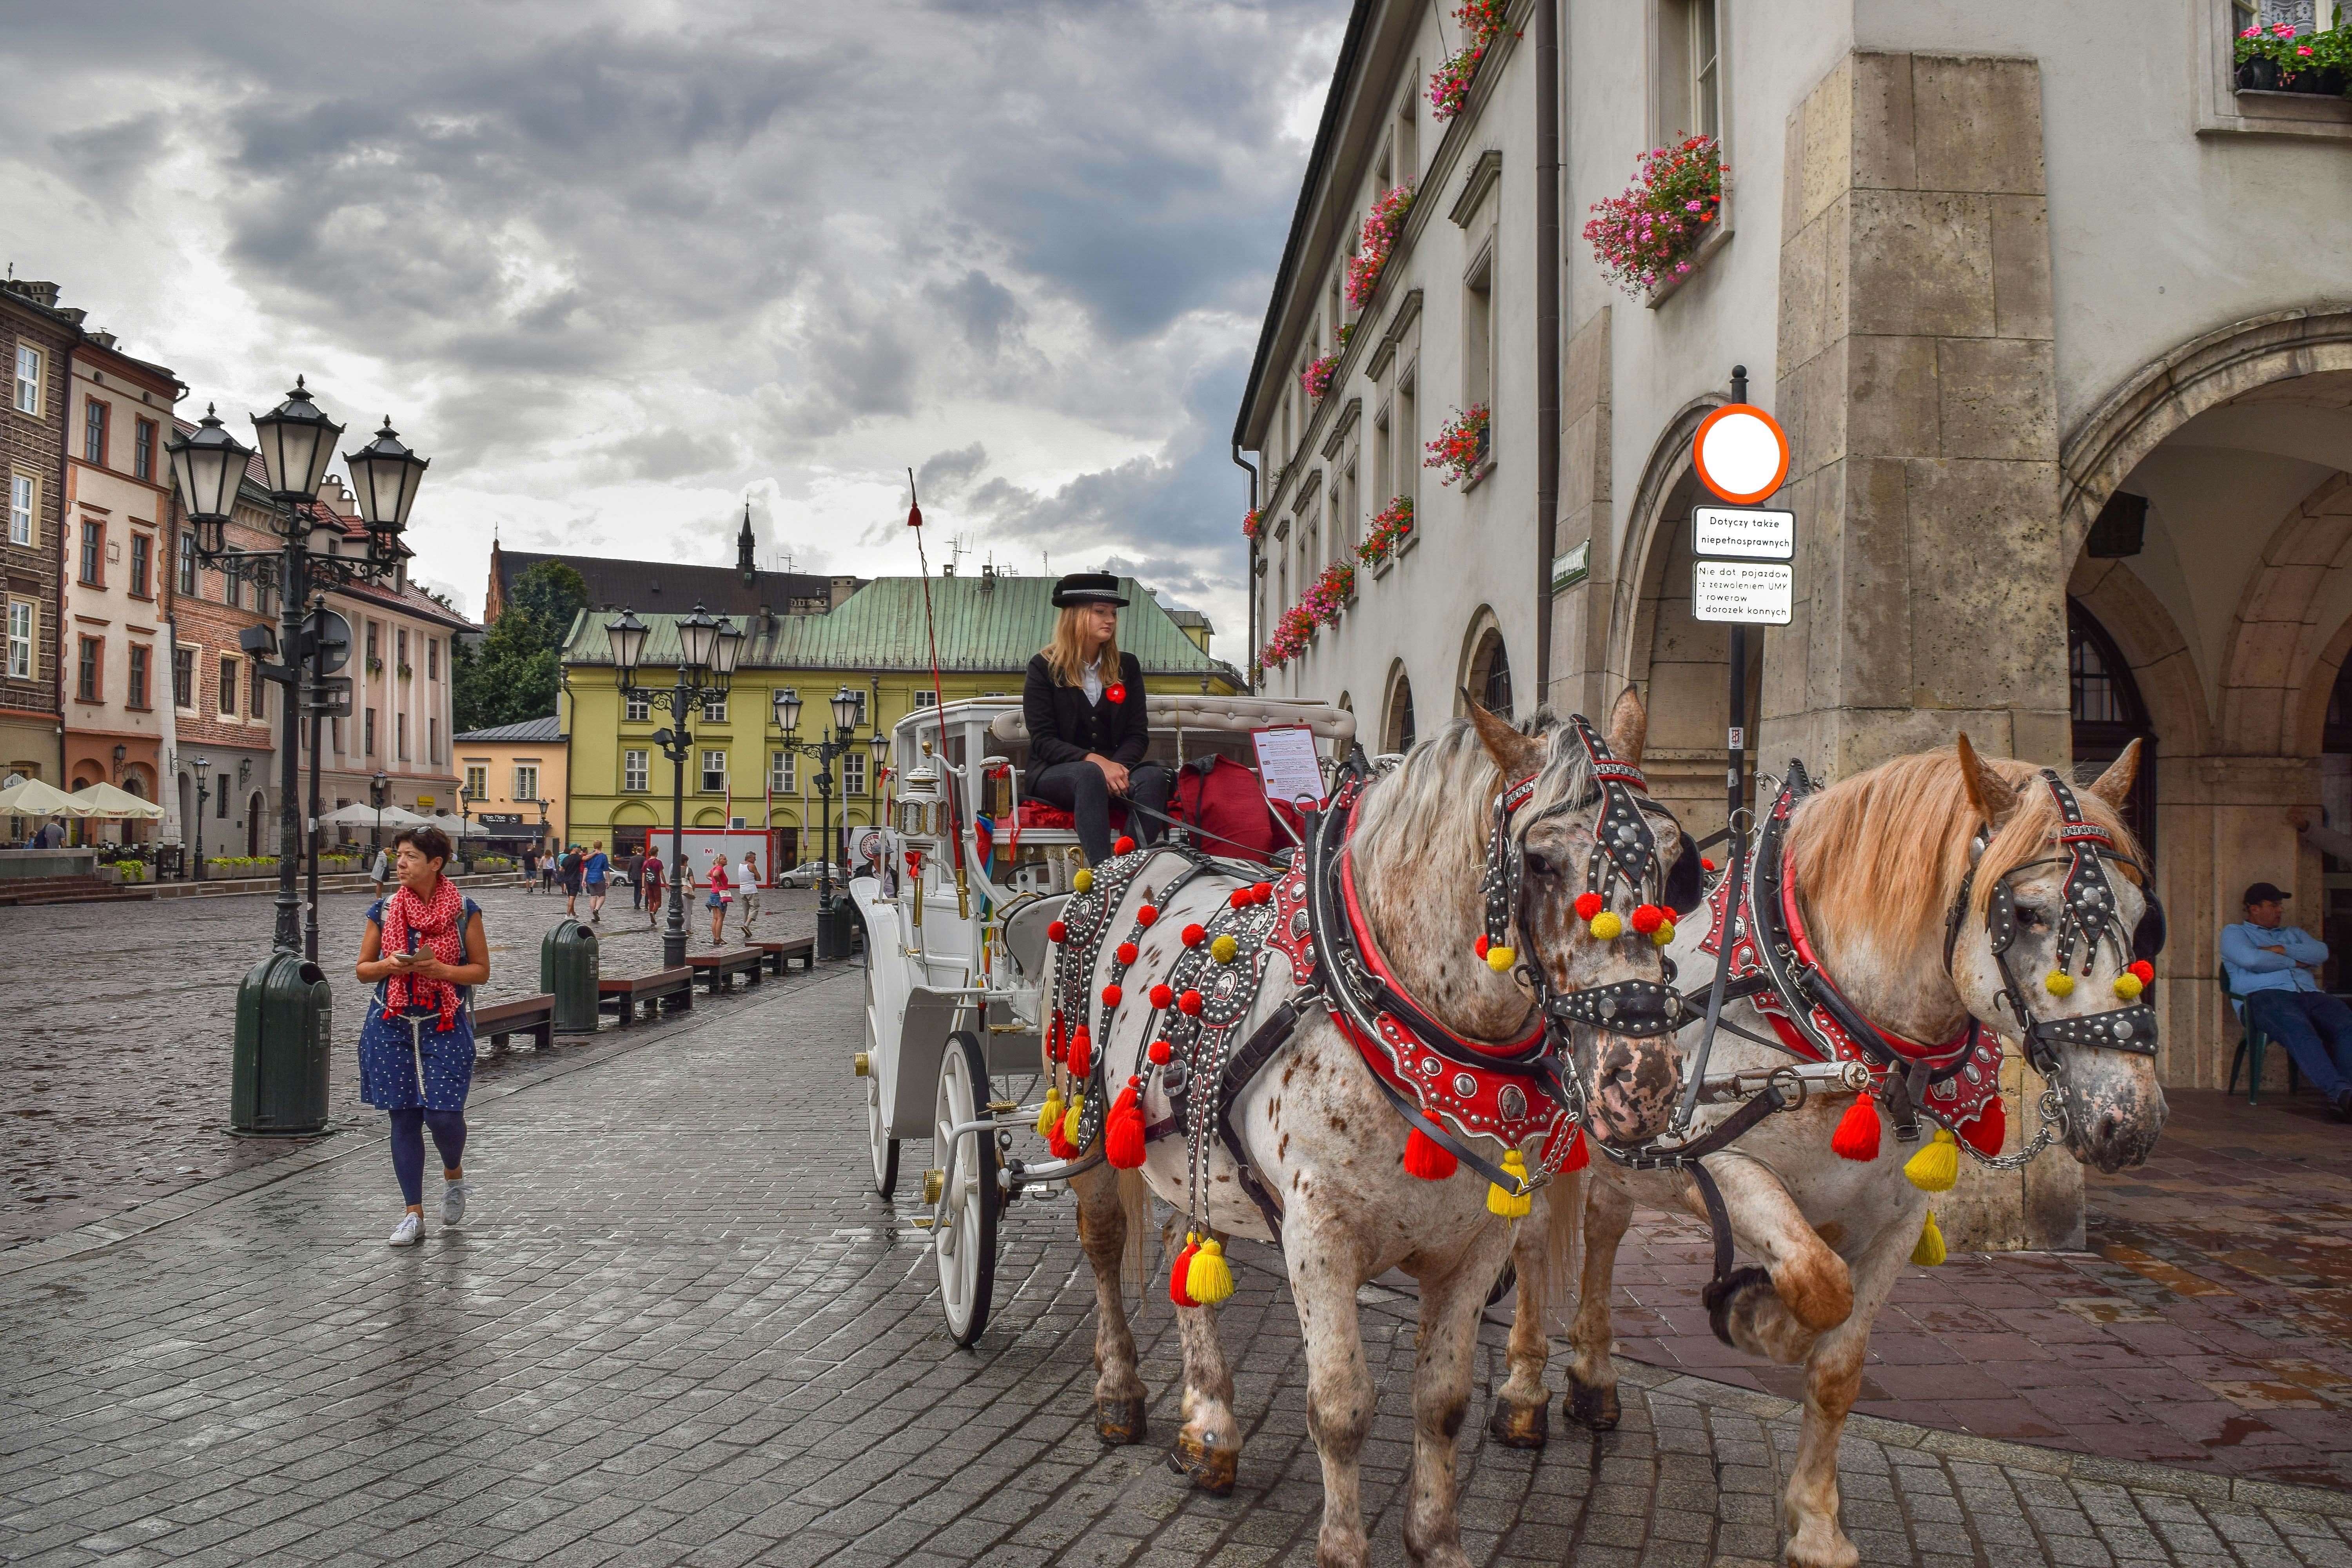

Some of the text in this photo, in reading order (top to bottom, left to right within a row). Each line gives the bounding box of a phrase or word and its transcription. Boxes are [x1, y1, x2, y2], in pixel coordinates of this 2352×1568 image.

[1710, 517, 1779, 528] Dotyczy także
[1701, 535, 1789, 548] niepełnosprawnych
[1710, 581, 1764, 590] zezwoleniem
[1748, 606, 1786, 617] konnych
